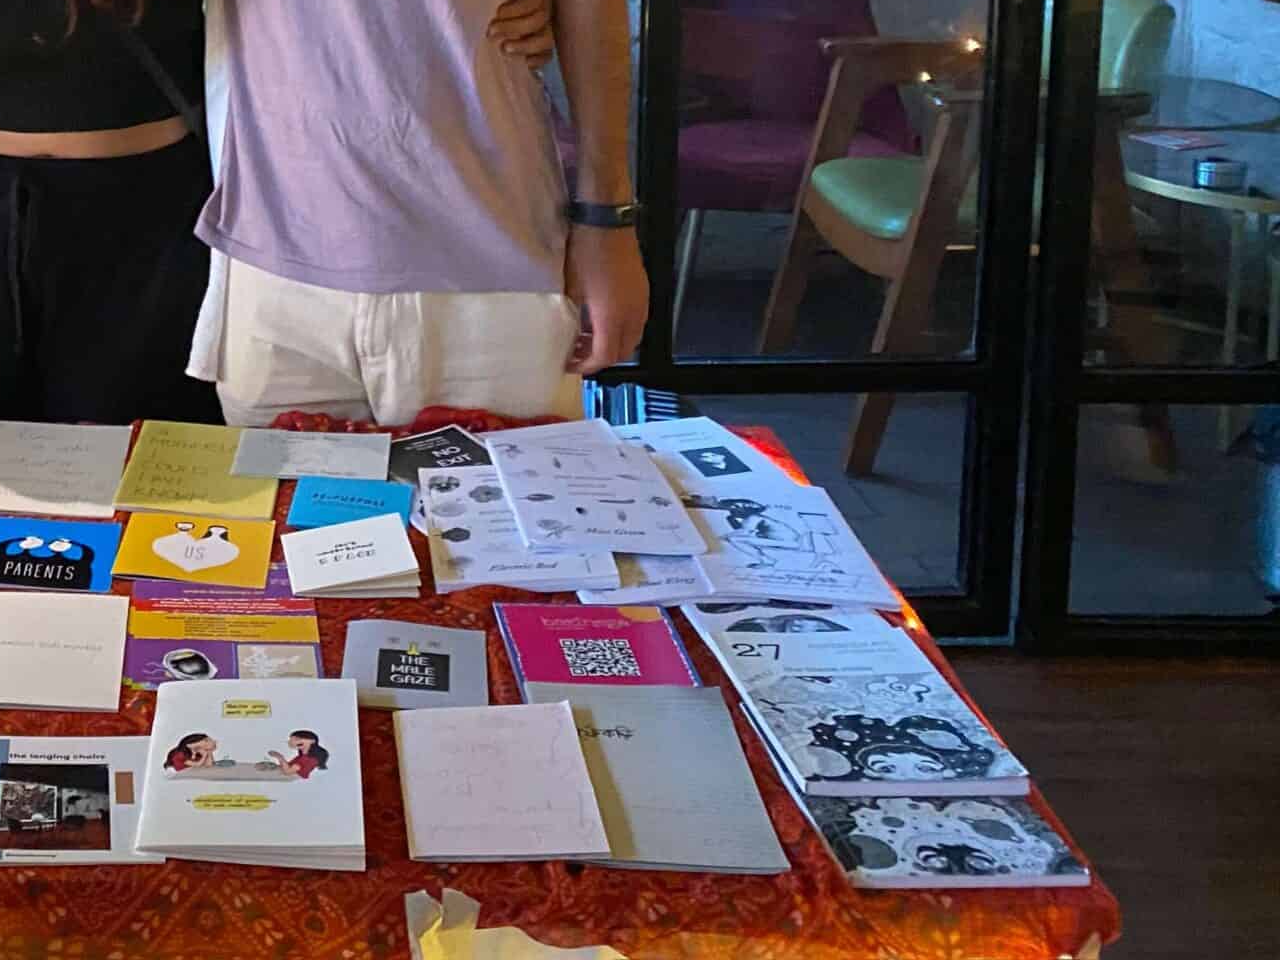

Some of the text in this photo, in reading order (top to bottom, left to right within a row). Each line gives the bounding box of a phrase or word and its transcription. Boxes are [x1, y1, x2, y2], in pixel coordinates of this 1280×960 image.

[431, 444, 462, 458] NO
[437, 454, 473, 467] EXIT
[183, 544, 207, 561] US
[3, 561, 75, 581] PARENTS
[731, 643, 780, 661] 27
[400, 655, 431, 666] THE
[391, 664, 435, 676] MALE
[390, 674, 437, 686] GAZE
